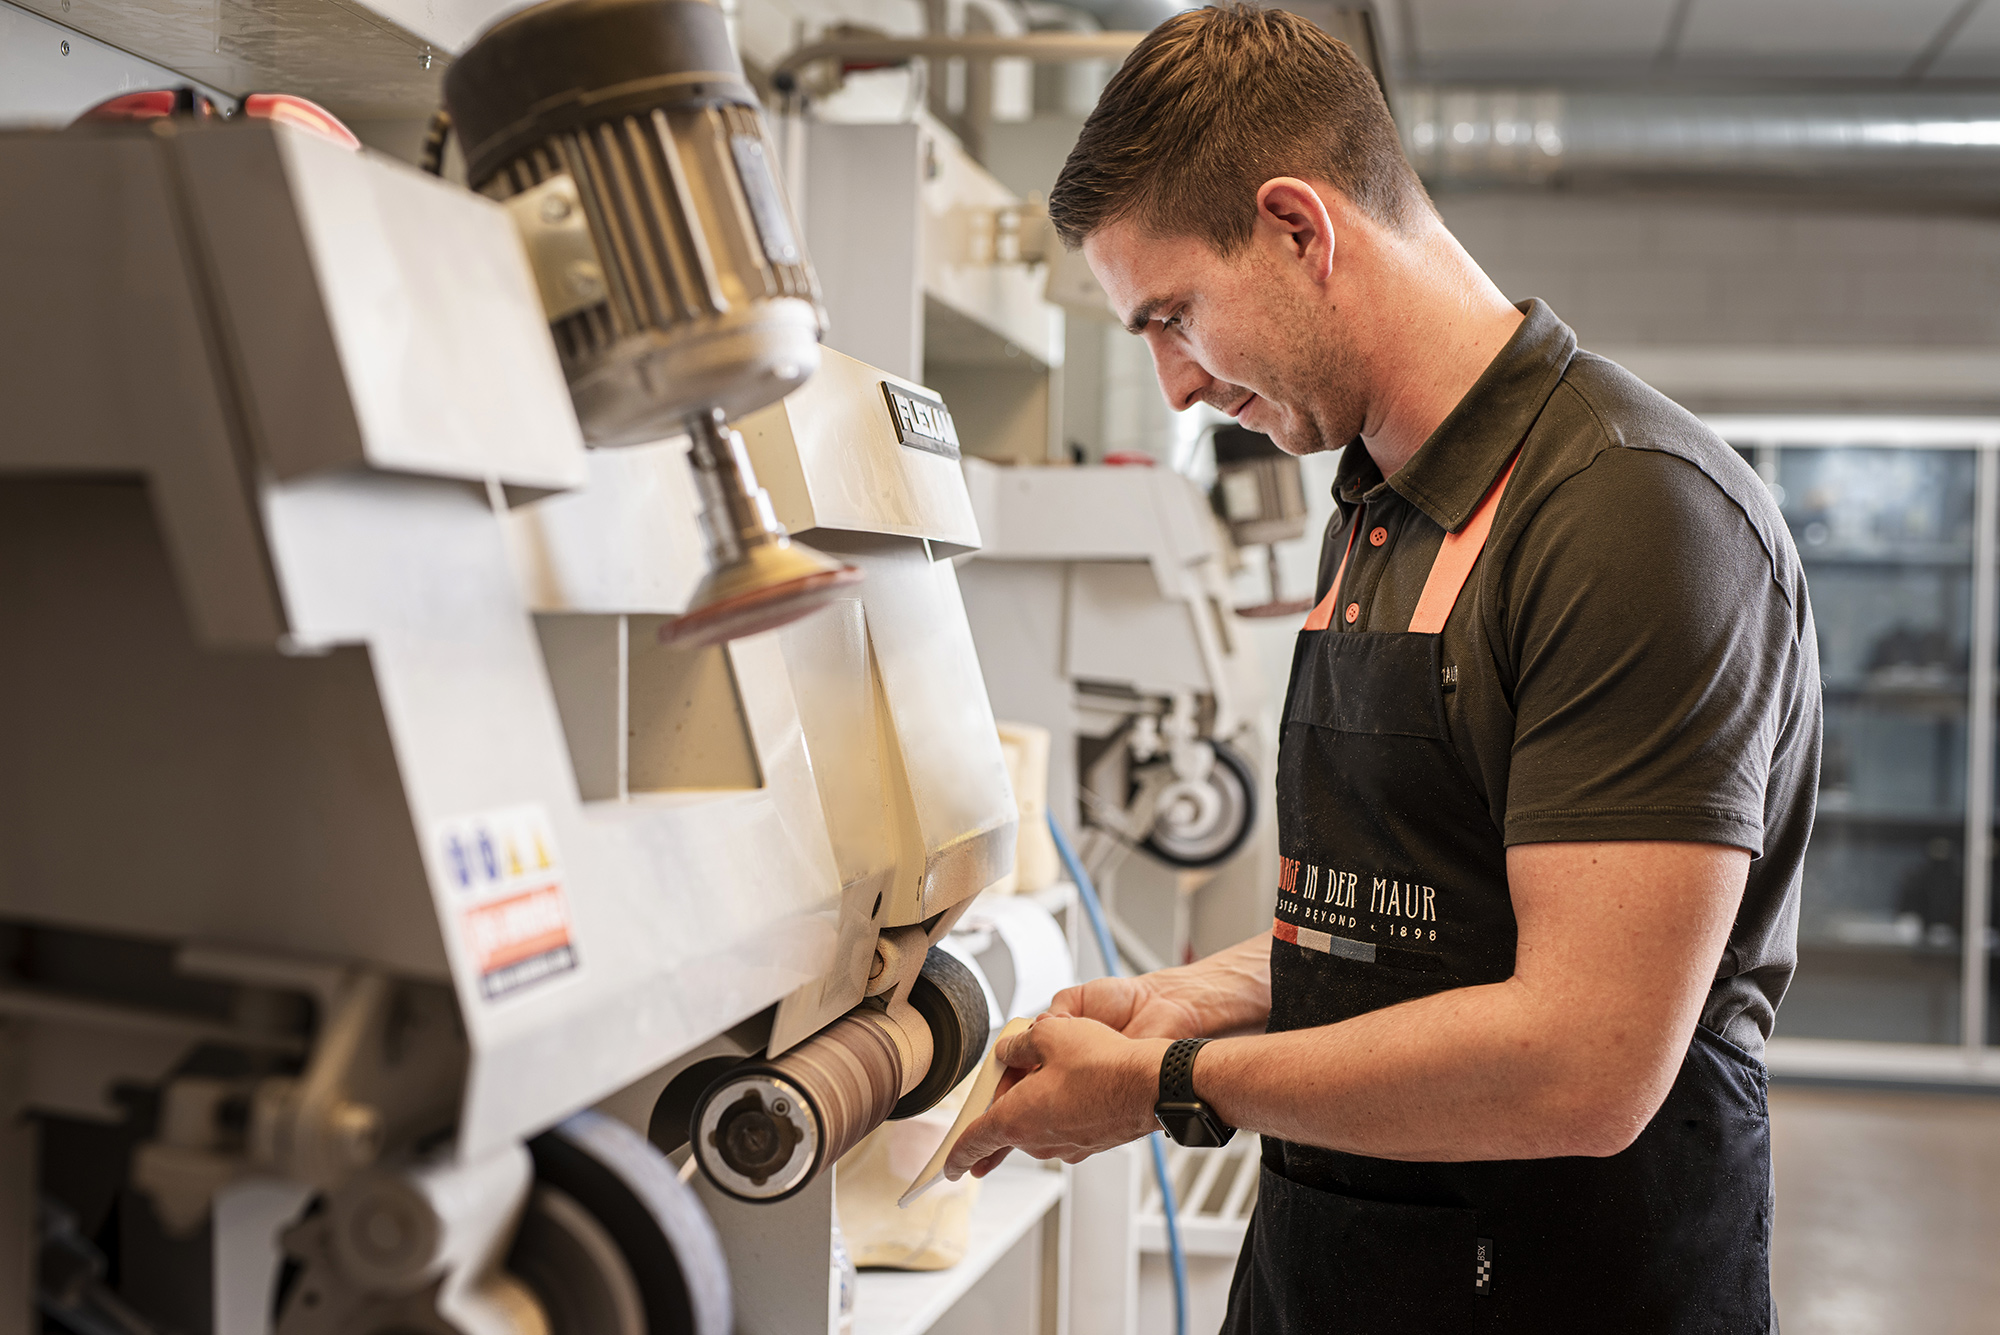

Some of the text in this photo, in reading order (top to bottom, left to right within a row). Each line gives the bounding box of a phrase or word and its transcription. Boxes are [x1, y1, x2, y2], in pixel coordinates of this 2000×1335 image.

[1303, 864, 1319, 900] IN
[1324, 868, 1358, 908] DER
[1370, 877, 1437, 922] MAUR
[1278, 899, 1437, 942] STEP BEYOND 1898
[1477, 1244, 1486, 1261] BSX
